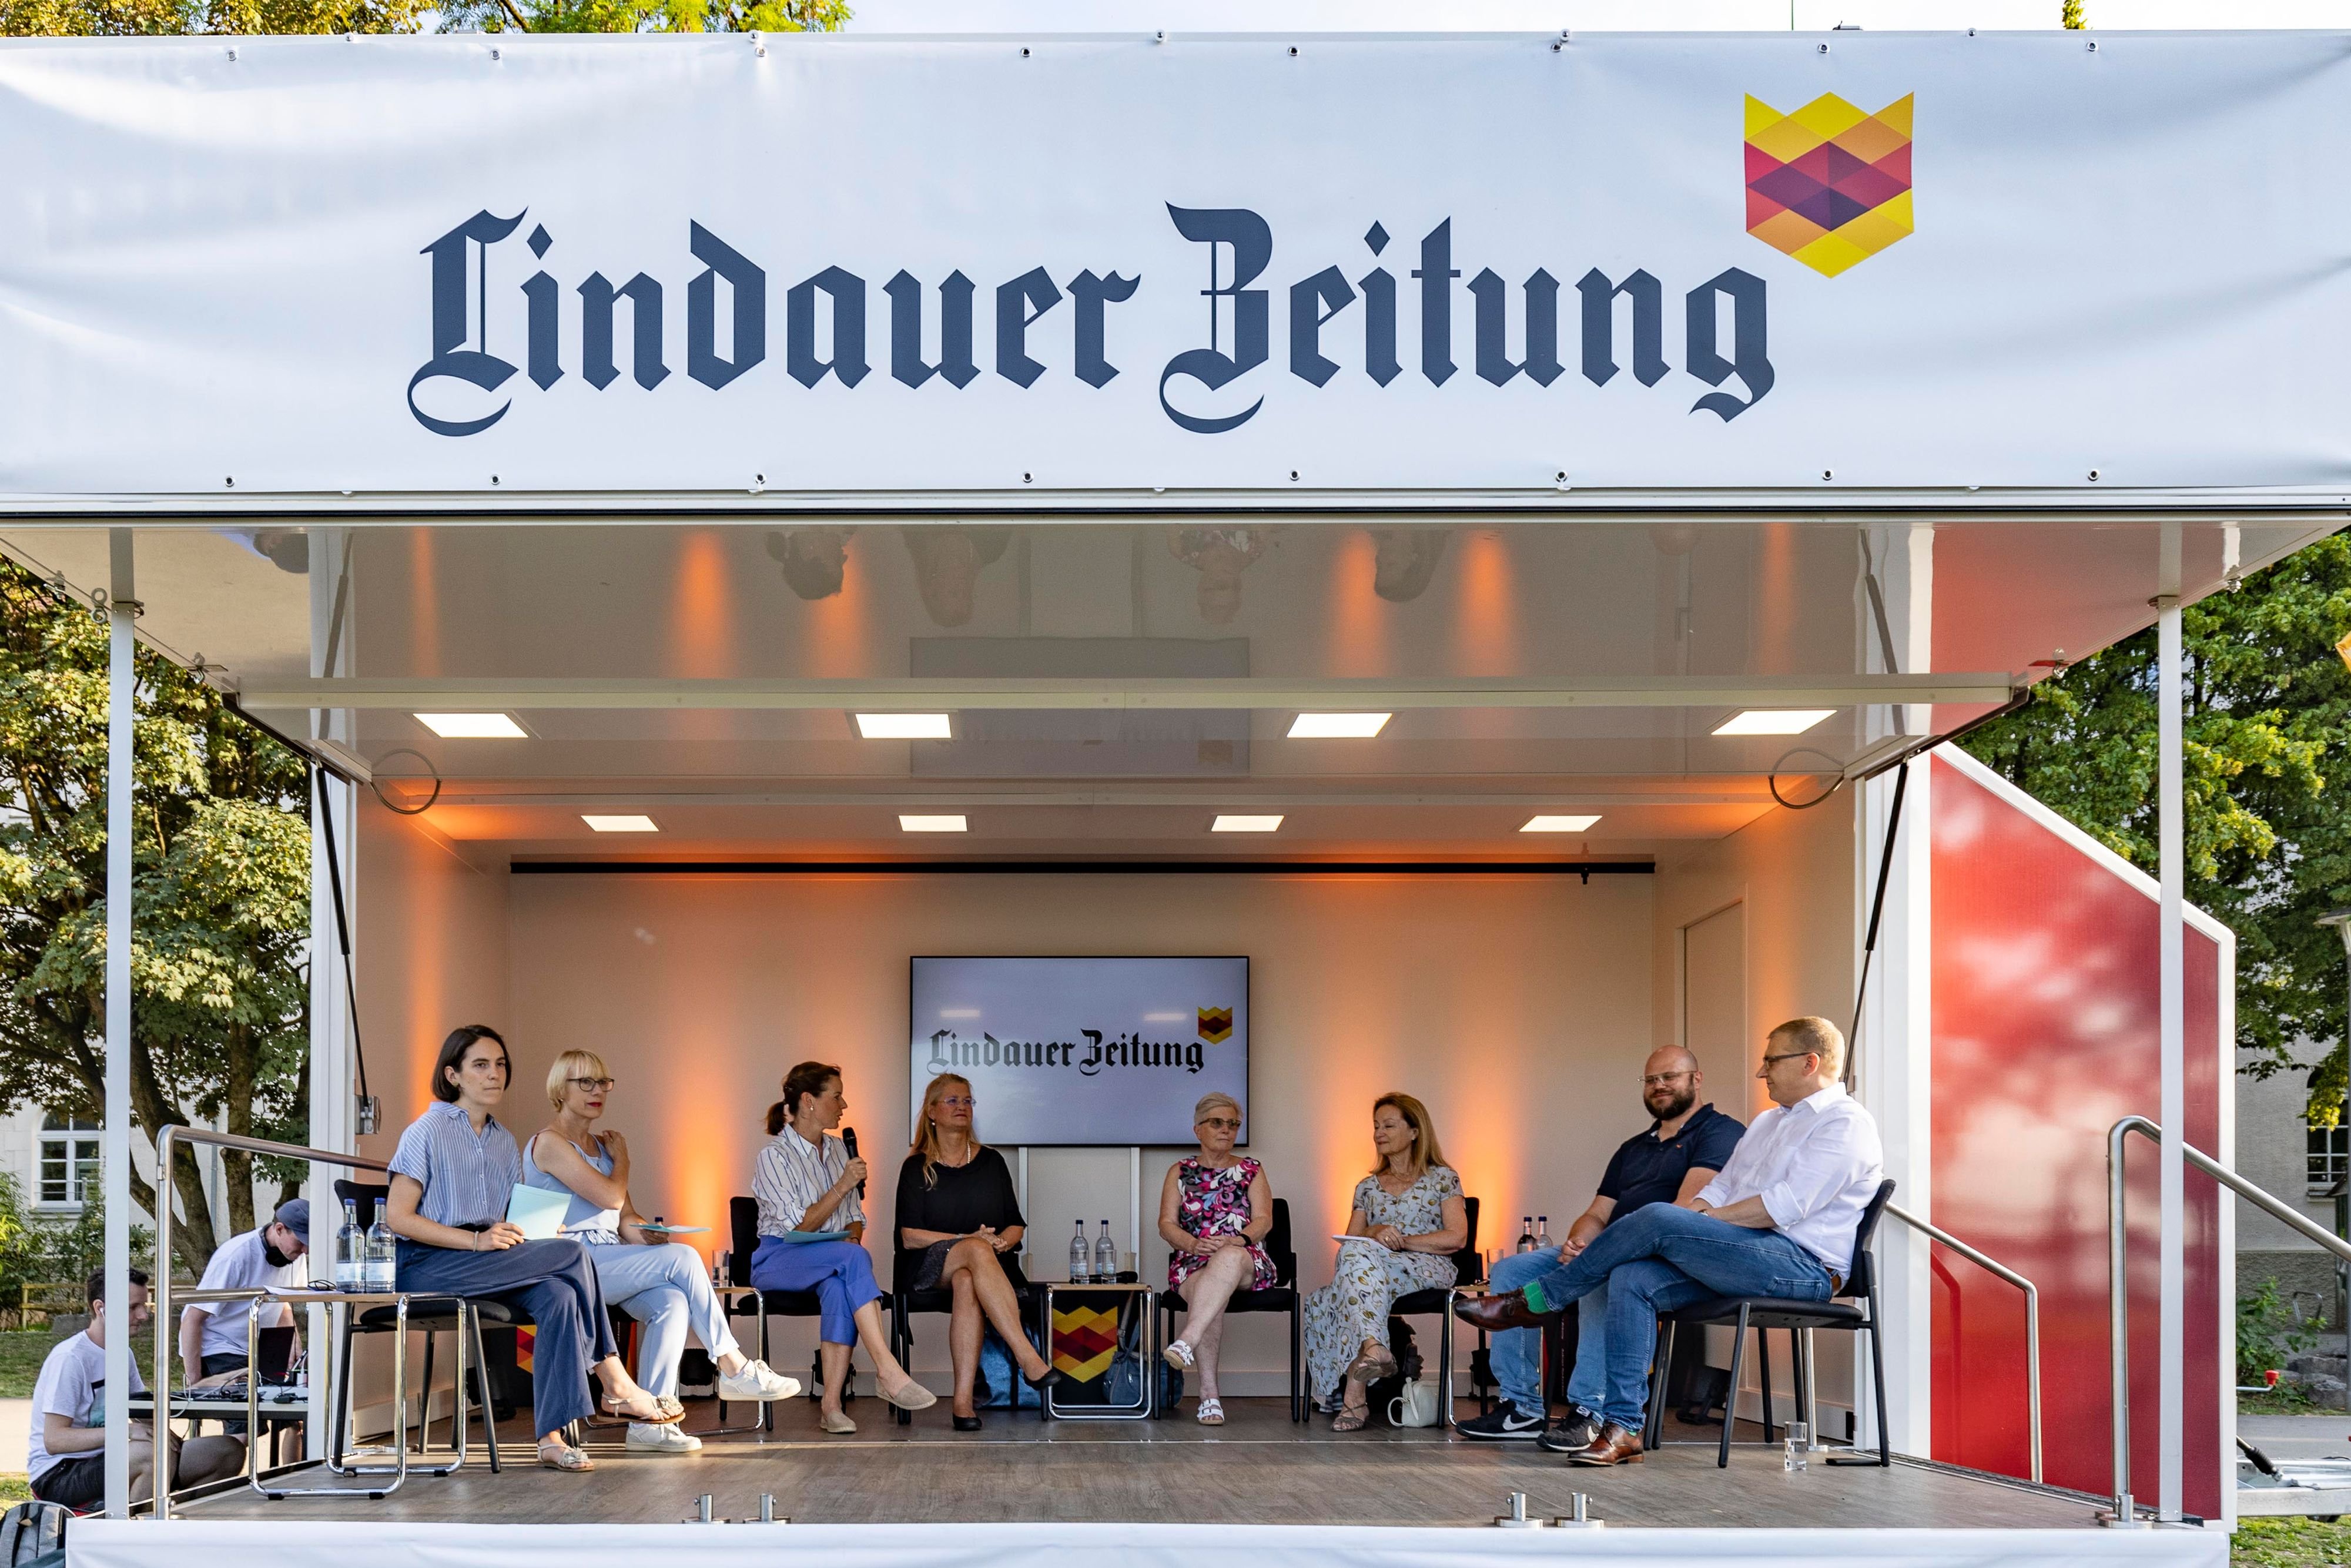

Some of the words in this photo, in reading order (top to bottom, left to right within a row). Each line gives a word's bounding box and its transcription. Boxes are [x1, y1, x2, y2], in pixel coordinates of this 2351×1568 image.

[407, 206, 1141, 437] Lindauer
[1159, 200, 1775, 434] Zeitung
[927, 1029, 1076, 1076] Lindauer
[1079, 1028, 1204, 1076] Zeitung
